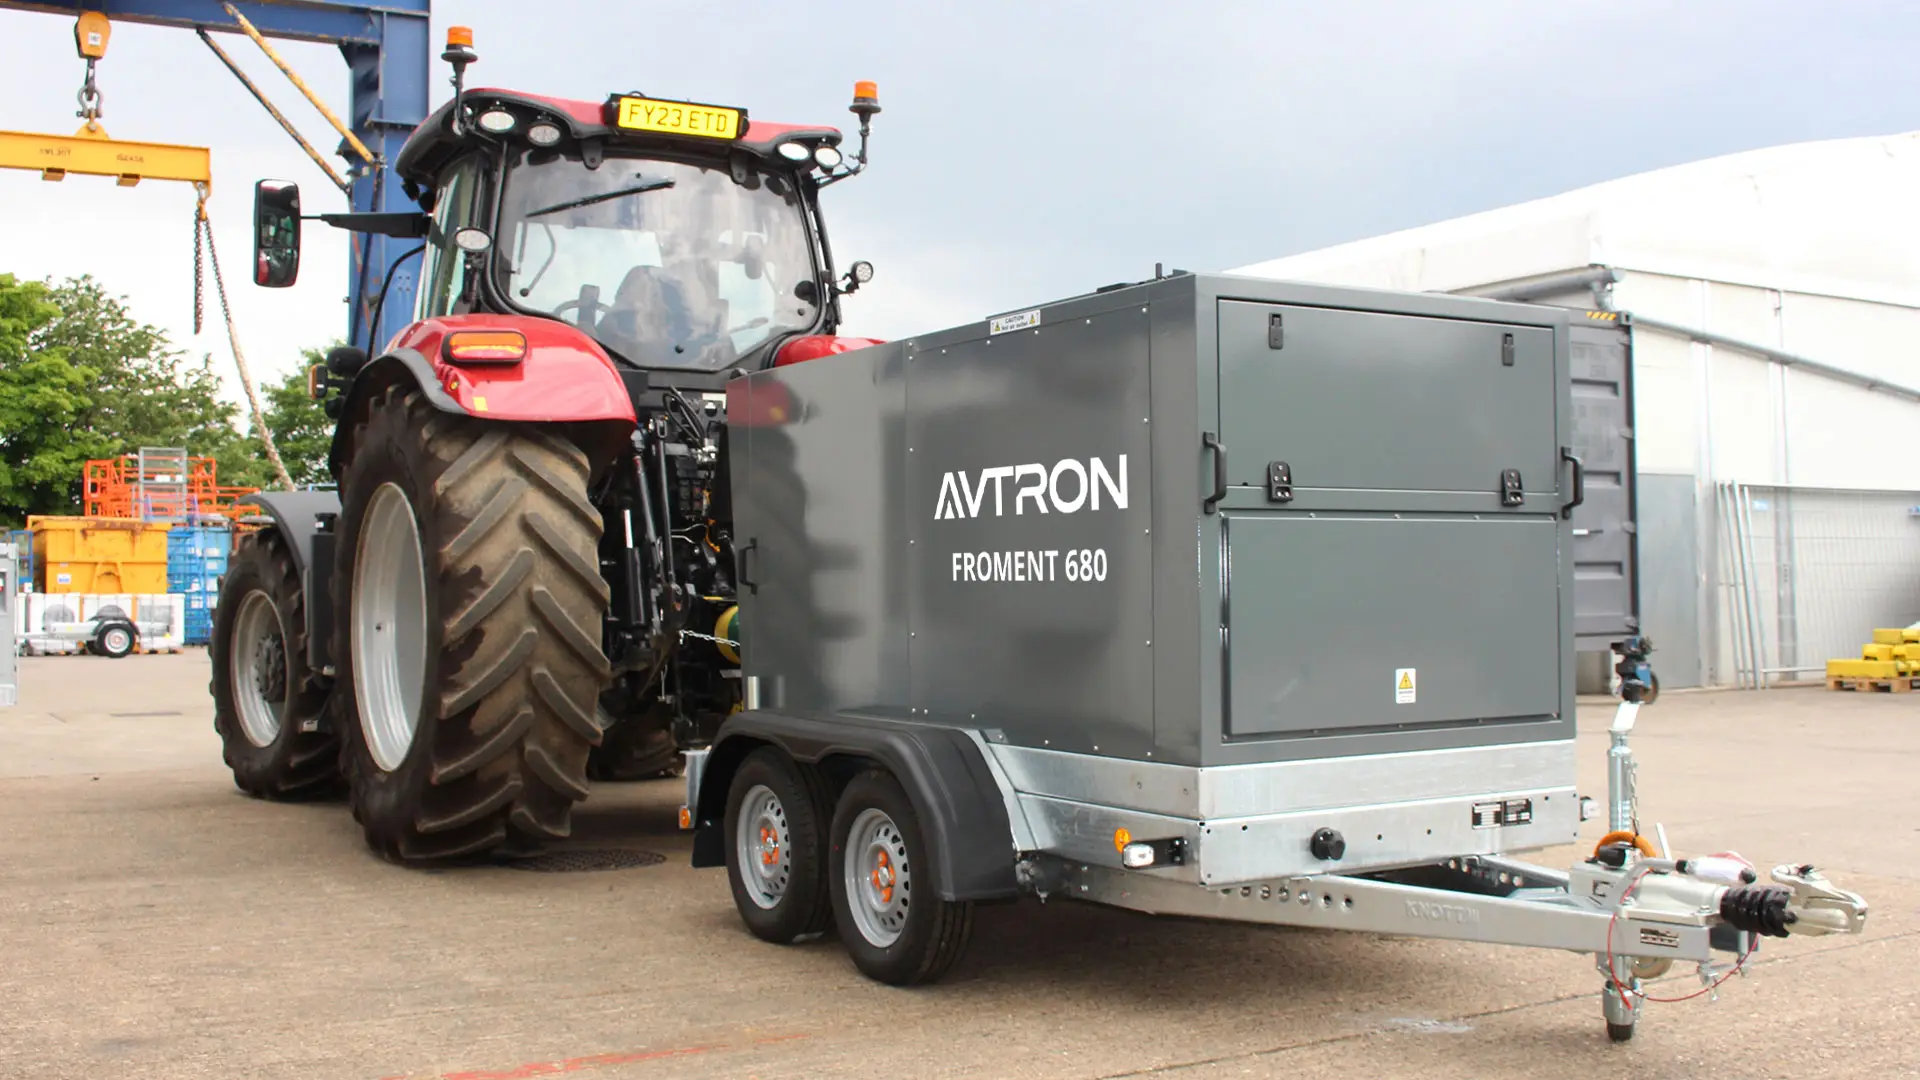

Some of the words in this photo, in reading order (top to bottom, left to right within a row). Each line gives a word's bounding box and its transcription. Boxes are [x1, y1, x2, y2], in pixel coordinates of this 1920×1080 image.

[629, 103, 682, 127] FY23
[689, 111, 727, 132] ETD
[934, 454, 1128, 519] AVTRON
[952, 551, 1059, 582] FROMENT
[1065, 548, 1107, 582] 680
